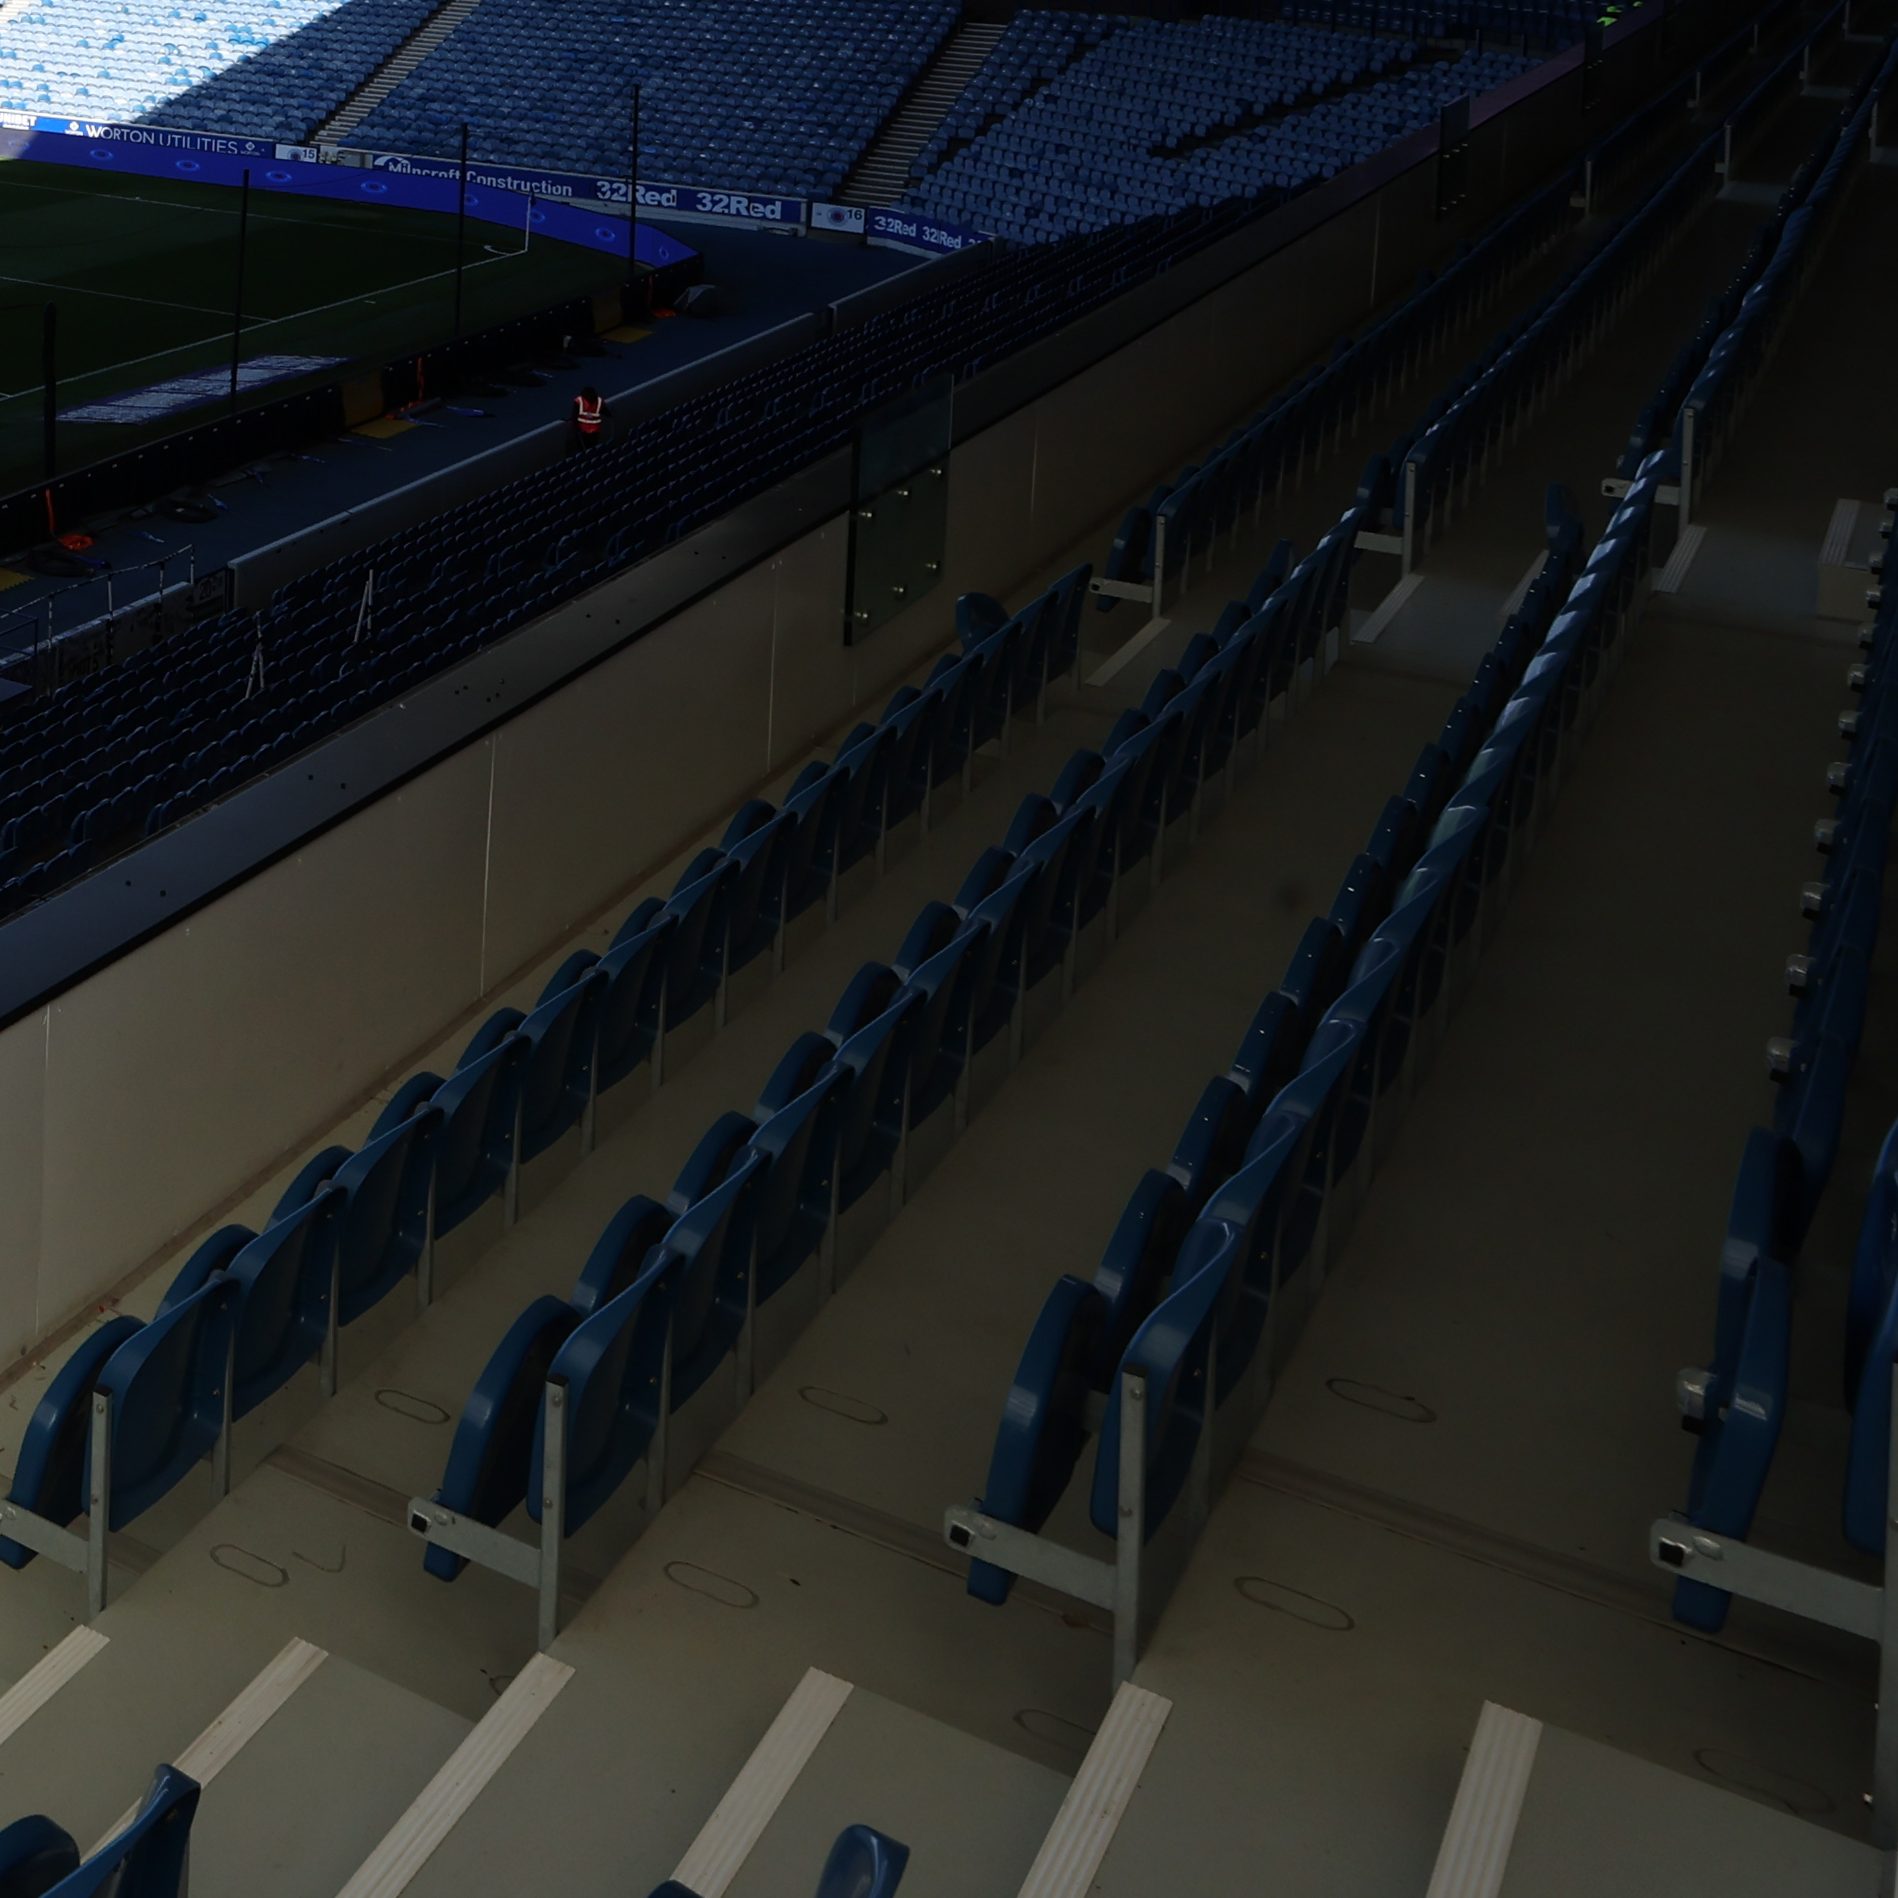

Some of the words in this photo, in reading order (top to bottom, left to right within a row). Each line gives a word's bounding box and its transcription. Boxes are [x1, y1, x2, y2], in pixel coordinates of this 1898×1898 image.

[86, 124, 155, 145] WORTON
[159, 131, 238, 155] UTILITIES
[302, 148, 316, 160] 15
[466, 169, 573, 197] Construction
[595, 181, 678, 208] 32Red
[696, 191, 782, 221] 32Red
[847, 208, 863, 221] 16
[873, 215, 917, 238] 32Red
[922, 226, 963, 250] 32Red
